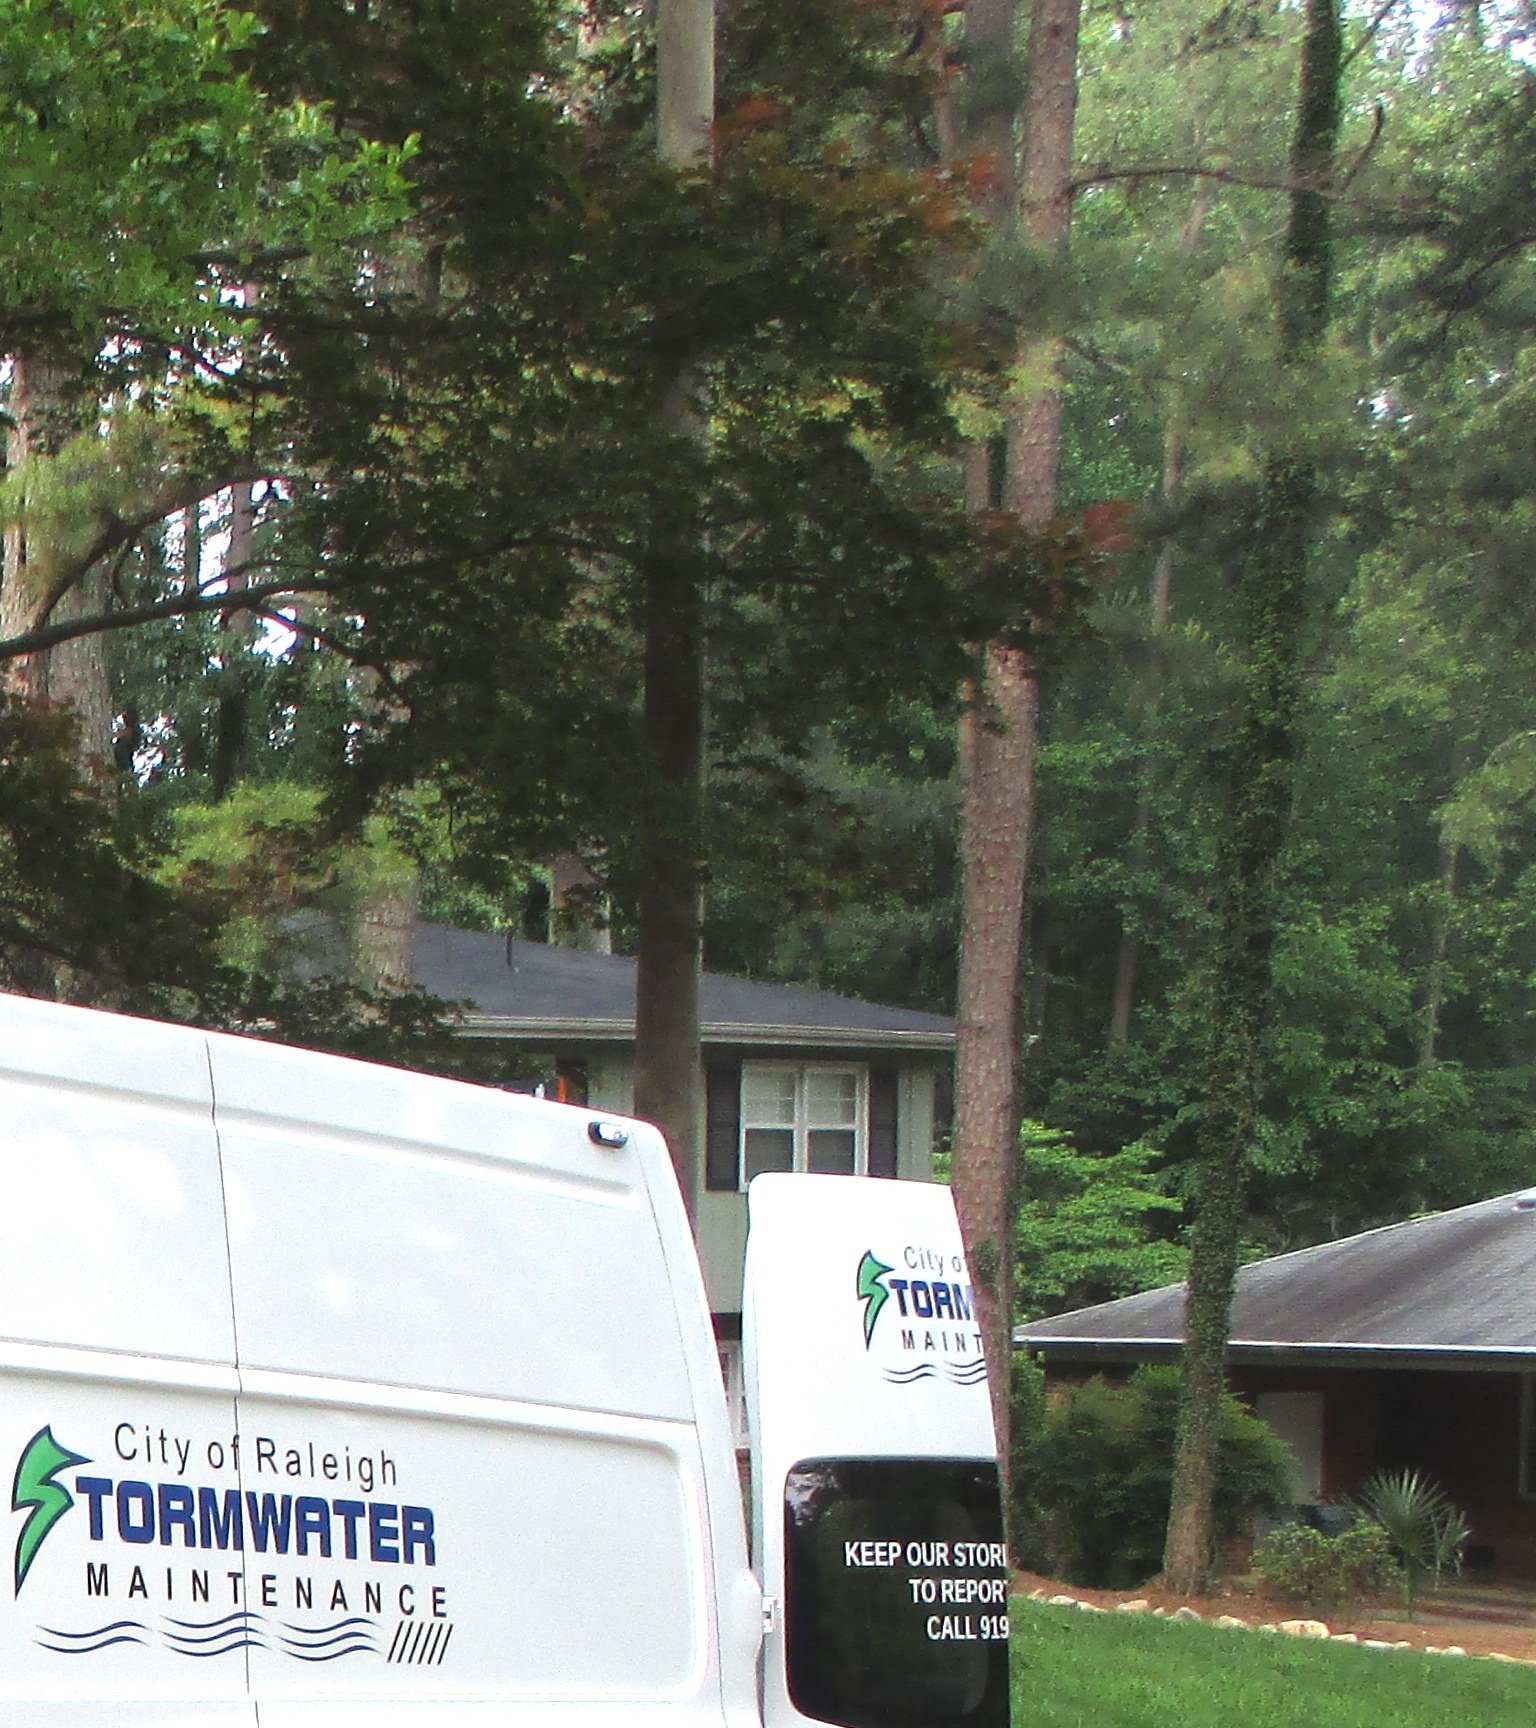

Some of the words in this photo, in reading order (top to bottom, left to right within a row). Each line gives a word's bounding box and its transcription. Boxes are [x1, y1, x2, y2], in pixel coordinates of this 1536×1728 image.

[904, 1246, 944, 1277] City
[114, 1422, 191, 1476] City
[207, 1433, 241, 1471] of
[256, 1436, 397, 1493] Raleigh
[844, 1541, 901, 1567] KEEP
[906, 1541, 950, 1567] OUR
[953, 1542, 1007, 1567] STOR
[86, 1562, 448, 1618] MAINTENANCE
[908, 1578, 936, 1604] TO
[941, 1579, 1007, 1604] REPOR
[927, 1615, 977, 1641] CALL
[979, 1616, 1009, 1641] 919
